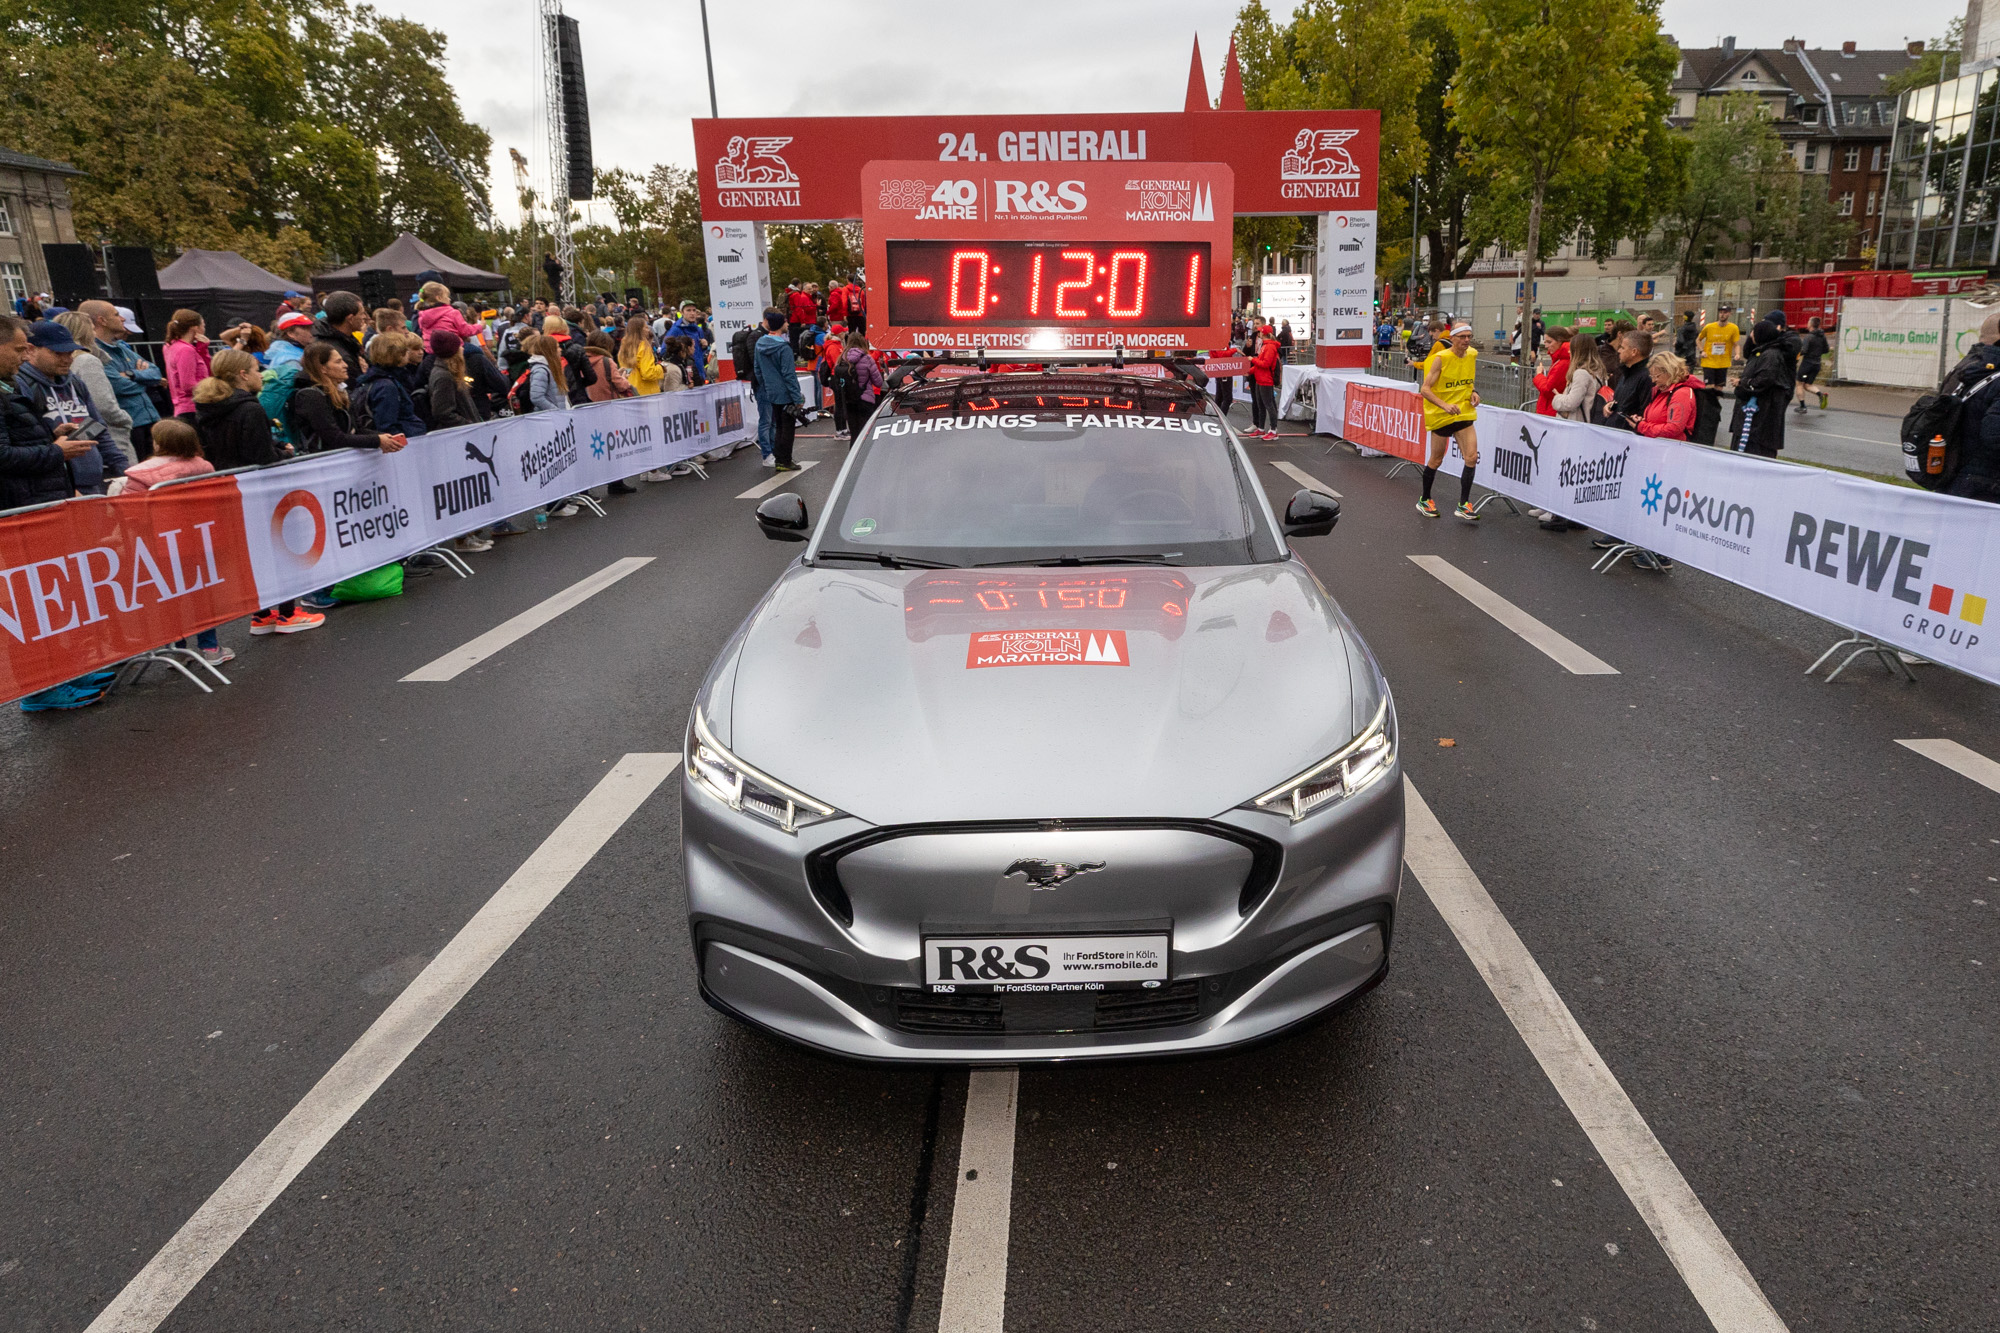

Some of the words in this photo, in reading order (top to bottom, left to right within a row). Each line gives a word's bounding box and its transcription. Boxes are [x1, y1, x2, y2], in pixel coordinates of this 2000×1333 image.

[938, 132, 987, 162] 24.
[998, 130, 1147, 162] GENERALI
[931, 179, 978, 206] 40
[1140, 180, 1191, 190] GENERALI
[1280, 181, 1360, 199] GENERALI
[718, 189, 801, 208] GENERALI
[879, 194, 926, 210] 2022
[994, 180, 1088, 212] R&S
[1140, 191, 1191, 209] KÖLN
[915, 205, 978, 220] JAHRE
[1020, 213, 1037, 221] Köln
[1126, 211, 1191, 221] MARATHON
[1339, 244, 1360, 252] PUMA
[1342, 289, 1367, 297] pixum
[727, 301, 754, 309] pixum
[1333, 307, 1358, 316] REWE
[720, 320, 746, 329] REWE
[912, 333, 954, 347] 100%
[957, 333, 1037, 347] ELEKTRISC
[1097, 330, 1124, 347] FÜR
[1126, 333, 1189, 347] MORGEN.
[1863, 328, 1905, 344] Linkamp
[1908, 331, 1938, 345] GmbH
[1205, 362, 1243, 372] GENERALI
[662, 409, 700, 445] REWE
[872, 413, 1038, 440] FÜHRUNGS
[1065, 413, 1223, 438] FAHRZEUG
[1364, 403, 1422, 445] GENERALI
[520, 418, 577, 482] Reissdorf
[606, 424, 652, 461] pixum
[539, 446, 578, 490] ALKOHOLFREI
[1493, 446, 1532, 486] PUMA
[1558, 445, 1631, 488] Reissdorf
[334, 480, 389, 518] Rhein
[432, 471, 492, 520] PUMA
[1574, 482, 1622, 505] ALKOHOLFREI
[1663, 486, 1755, 539] pixum
[336, 505, 410, 549] Energie
[1675, 523, 1688, 535] DEIN
[1688, 527, 1751, 556] ONLINE-FOTOSERVICE
[1784, 510, 1931, 606] REWE
[1002, 631, 1080, 641] GENERALI
[1902, 613, 1980, 650] GROUP
[1001, 638, 1081, 654] KÖLN
[977, 653, 1082, 665] MARATHON
[936, 944, 1051, 981] R&S
[1063, 952, 1075, 961] Ihr
[1076, 951, 1125, 961] FordStore
[1126, 951, 1134, 959] in
[1135, 950, 1158, 960] Köln.
[1063, 960, 1158, 971] www.rsmobile.de
[933, 985, 956, 993] R&S
[993, 984, 1005, 992] Ihr
[1006, 983, 1050, 992] FordStore
[1050, 983, 1083, 992] Partner
[1084, 982, 1104, 991] Köln
